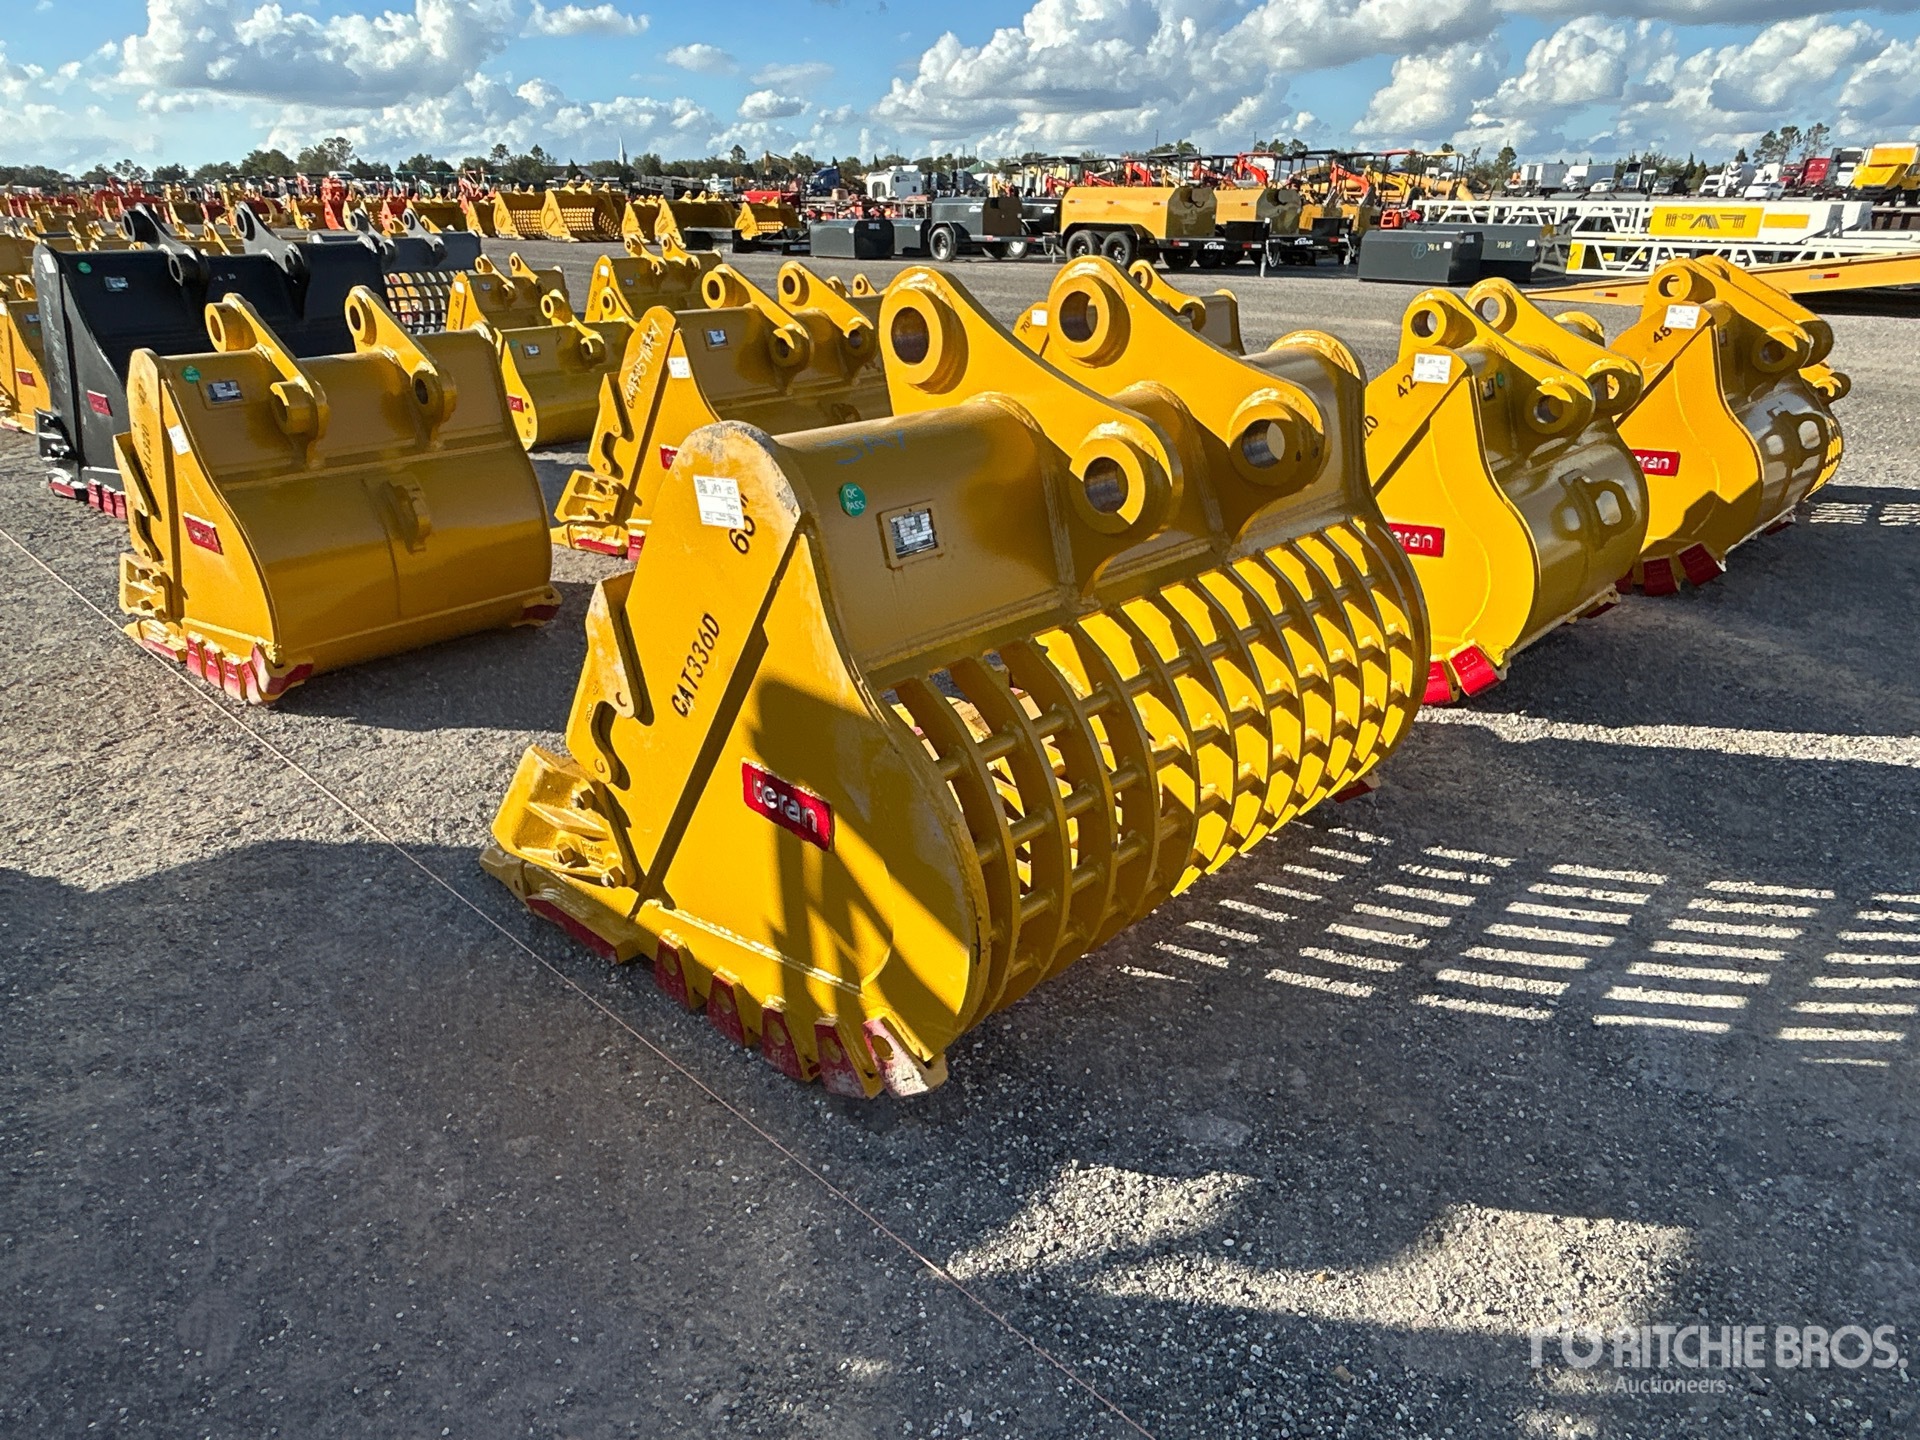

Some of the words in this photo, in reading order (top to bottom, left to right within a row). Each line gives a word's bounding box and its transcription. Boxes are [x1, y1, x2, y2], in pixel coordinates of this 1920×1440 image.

[846, 487, 859, 499] QC
[846, 500, 865, 511] PASS
[1392, 531, 1434, 549] eran
[671, 612, 721, 718] CAT336D
[751, 773, 819, 834] teran
